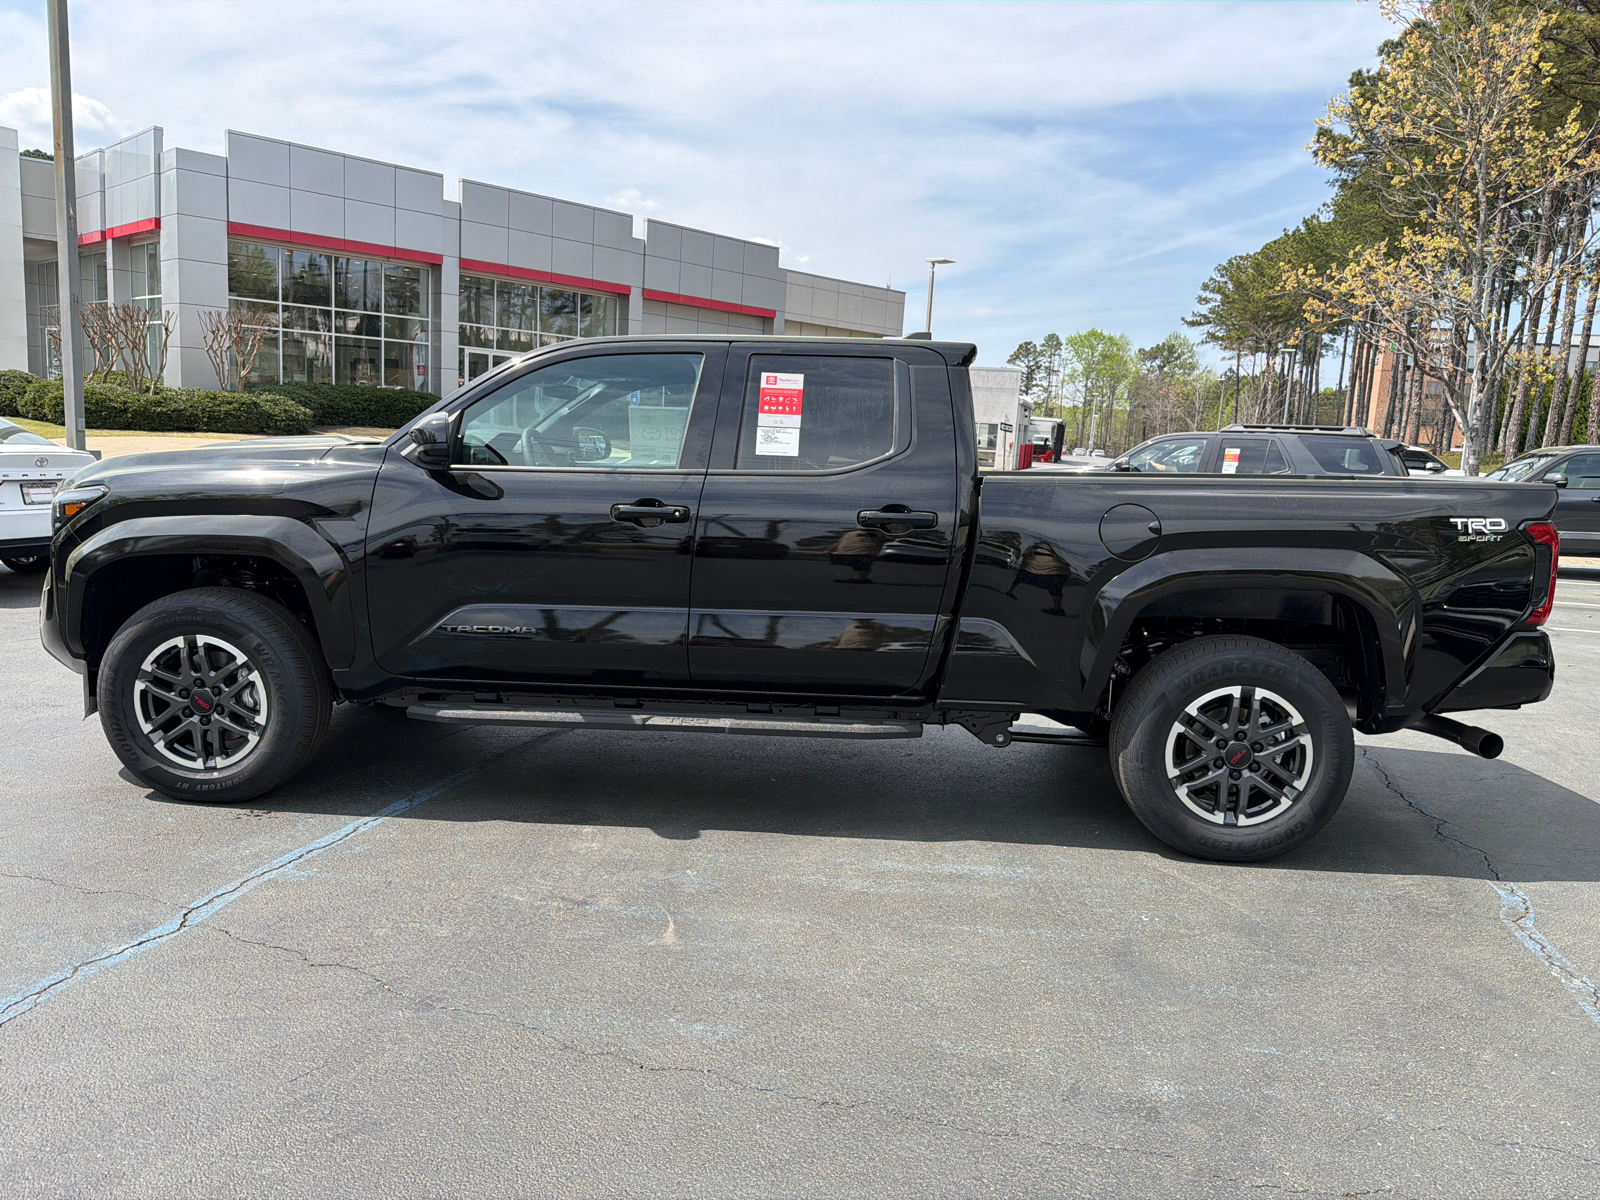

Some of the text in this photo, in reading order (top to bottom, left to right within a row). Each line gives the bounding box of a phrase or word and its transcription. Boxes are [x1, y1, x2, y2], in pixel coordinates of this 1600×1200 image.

[1449, 518, 1508, 533] TRD
[441, 625, 537, 634] TACOMA
[1175, 661, 1288, 694] WRANGLER
[253, 642, 288, 741] WRANGLER
[194, 695, 210, 710] TRD
[1230, 749, 1247, 764] TRD
[174, 772, 250, 791] TERRITORY HT
[1195, 821, 1306, 853] GOODYEAR
